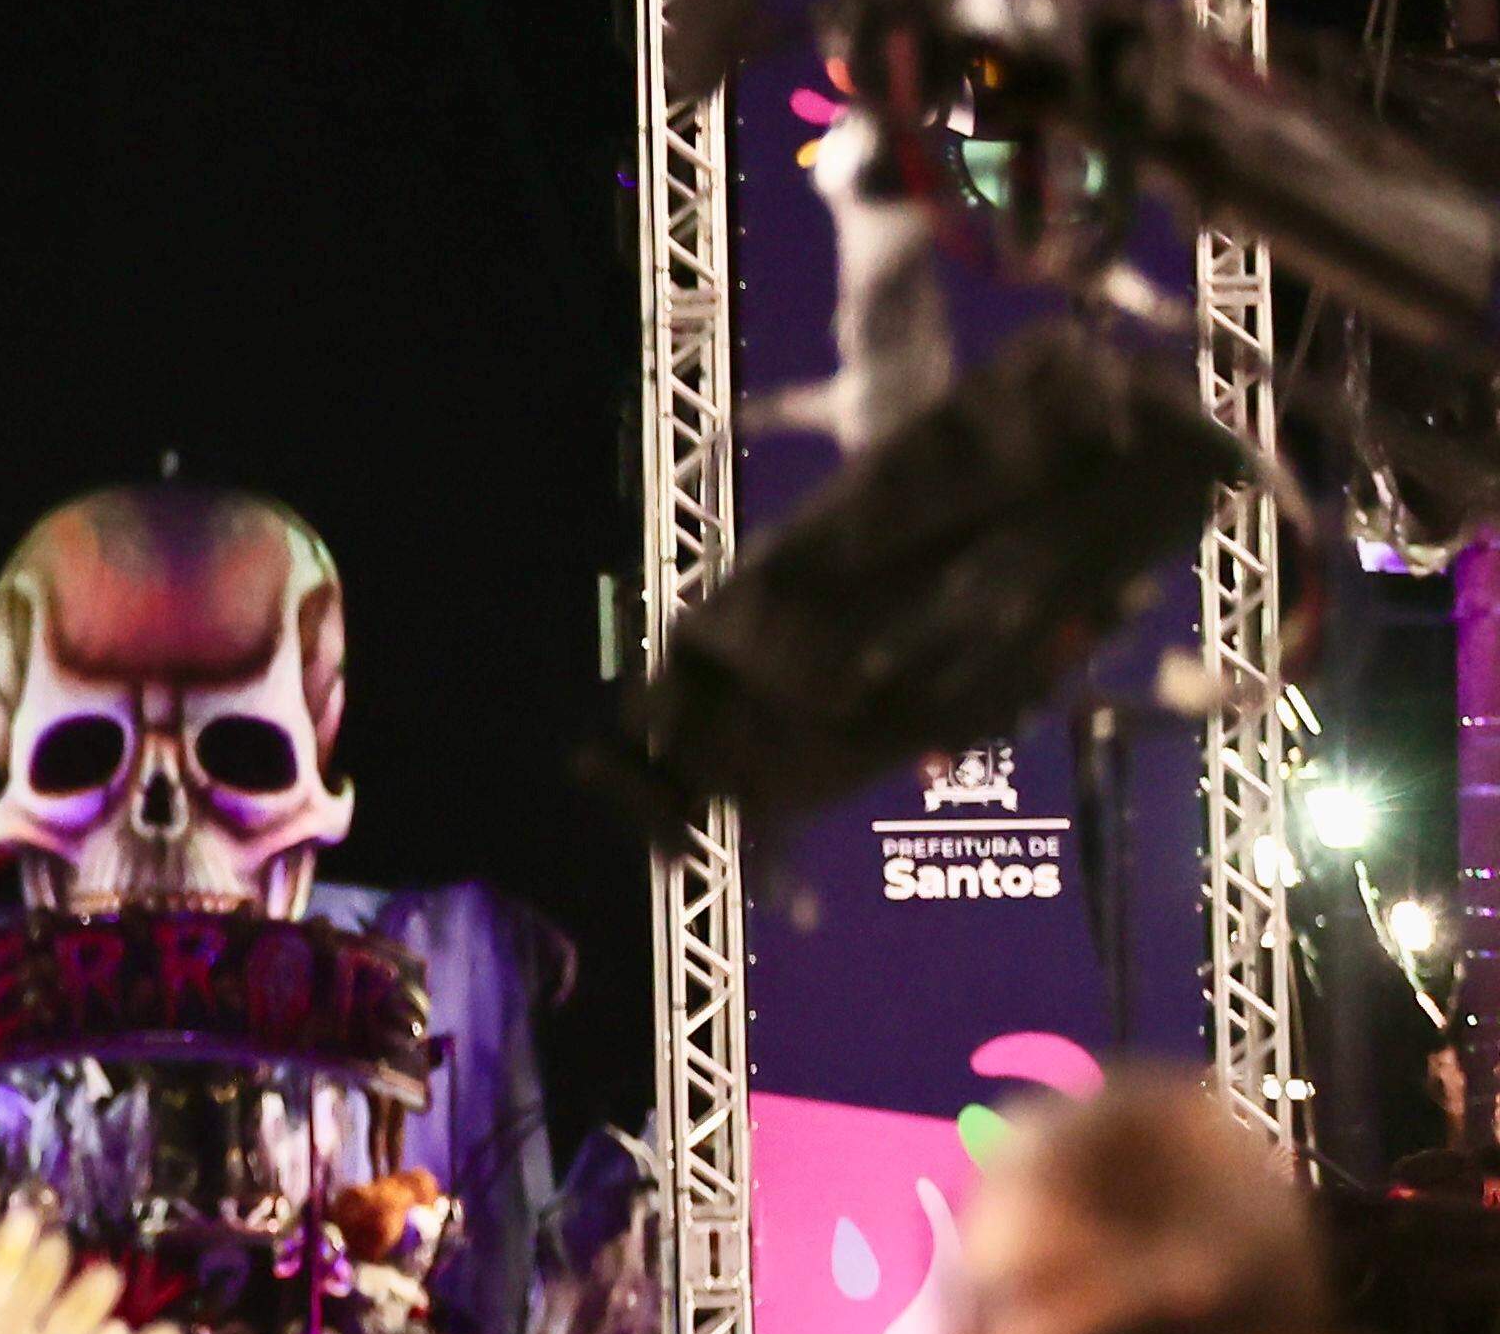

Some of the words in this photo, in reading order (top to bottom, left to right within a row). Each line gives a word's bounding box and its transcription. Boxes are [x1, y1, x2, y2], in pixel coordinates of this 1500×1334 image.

[882, 836, 1023, 858] PREFEITURA
[1028, 836, 1061, 857] DE
[883, 856, 1062, 901] Santos
